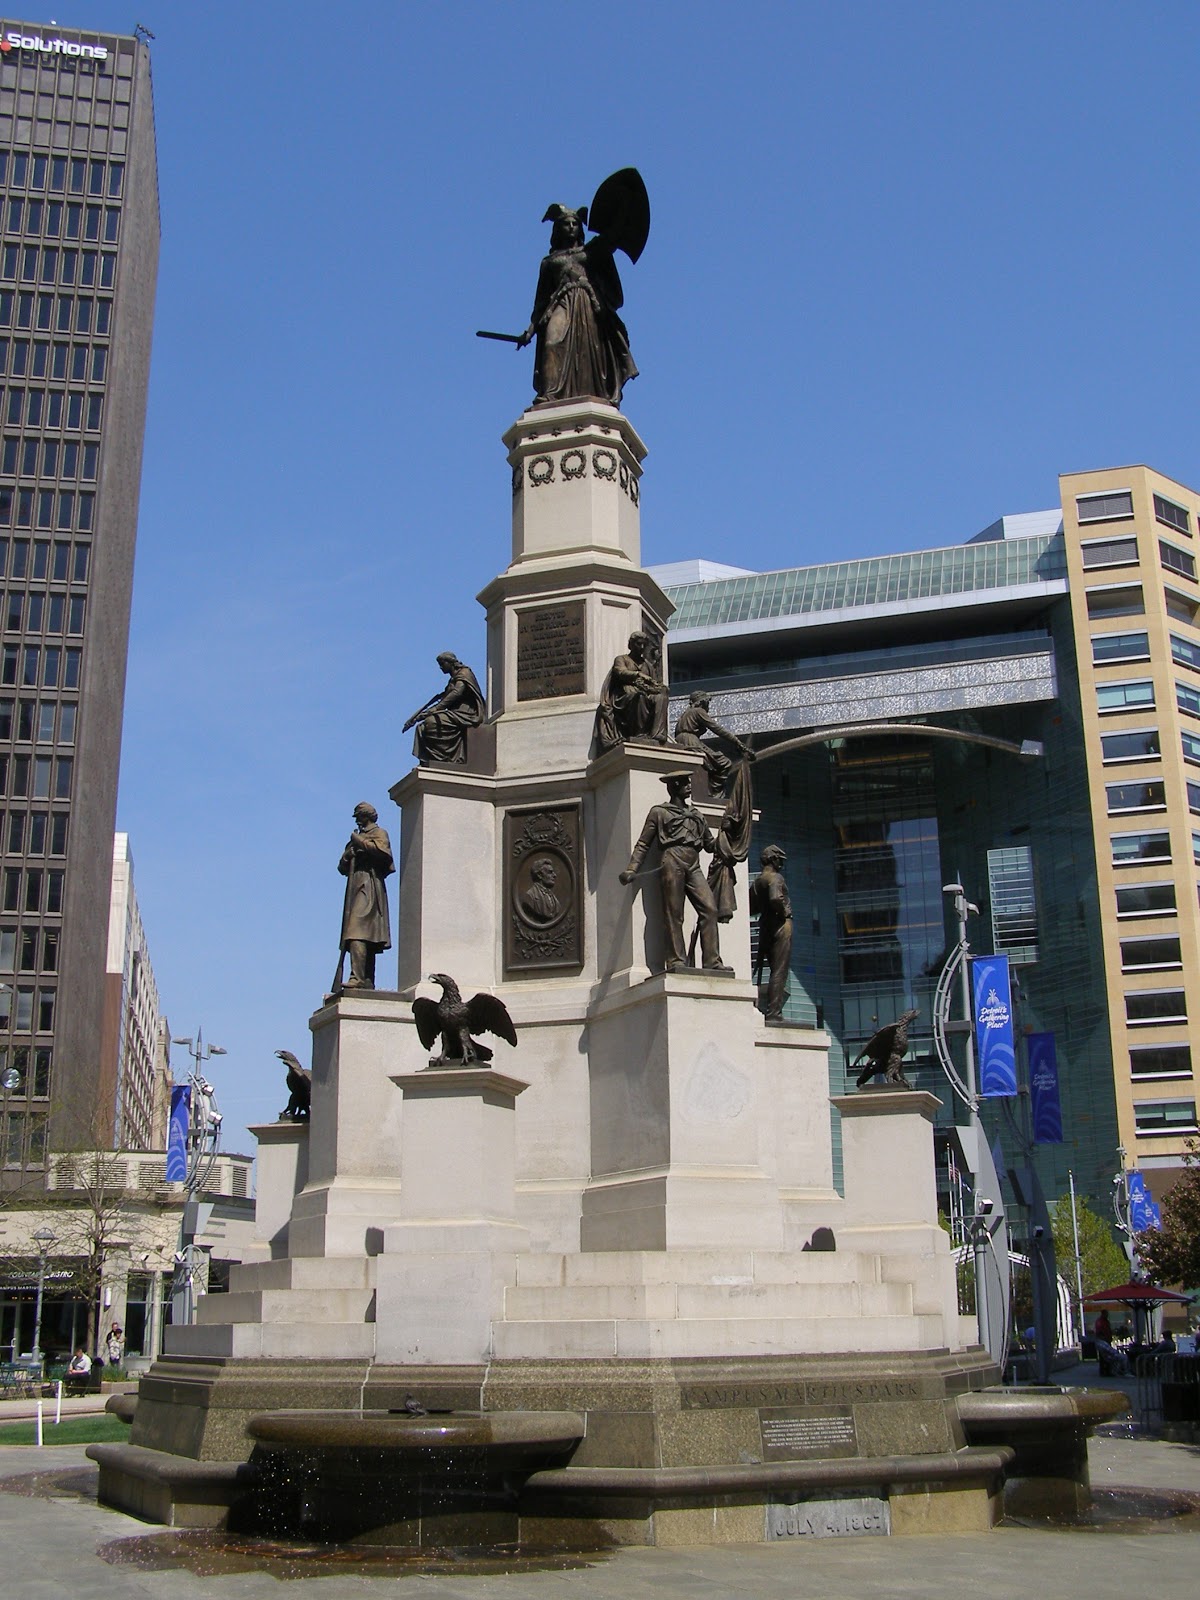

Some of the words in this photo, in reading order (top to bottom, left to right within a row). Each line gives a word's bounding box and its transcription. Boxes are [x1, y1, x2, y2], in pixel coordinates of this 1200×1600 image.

[980, 1006, 1007, 1014] Detroit's
[978, 1013, 1010, 1024] Gathering
[986, 1021, 1004, 1029] Place
[684, 1387, 768, 1404] CAMPUS
[773, 1385, 863, 1401] MARTIUS
[868, 1383, 918, 1397] PARK
[775, 1518, 816, 1537] JULY
